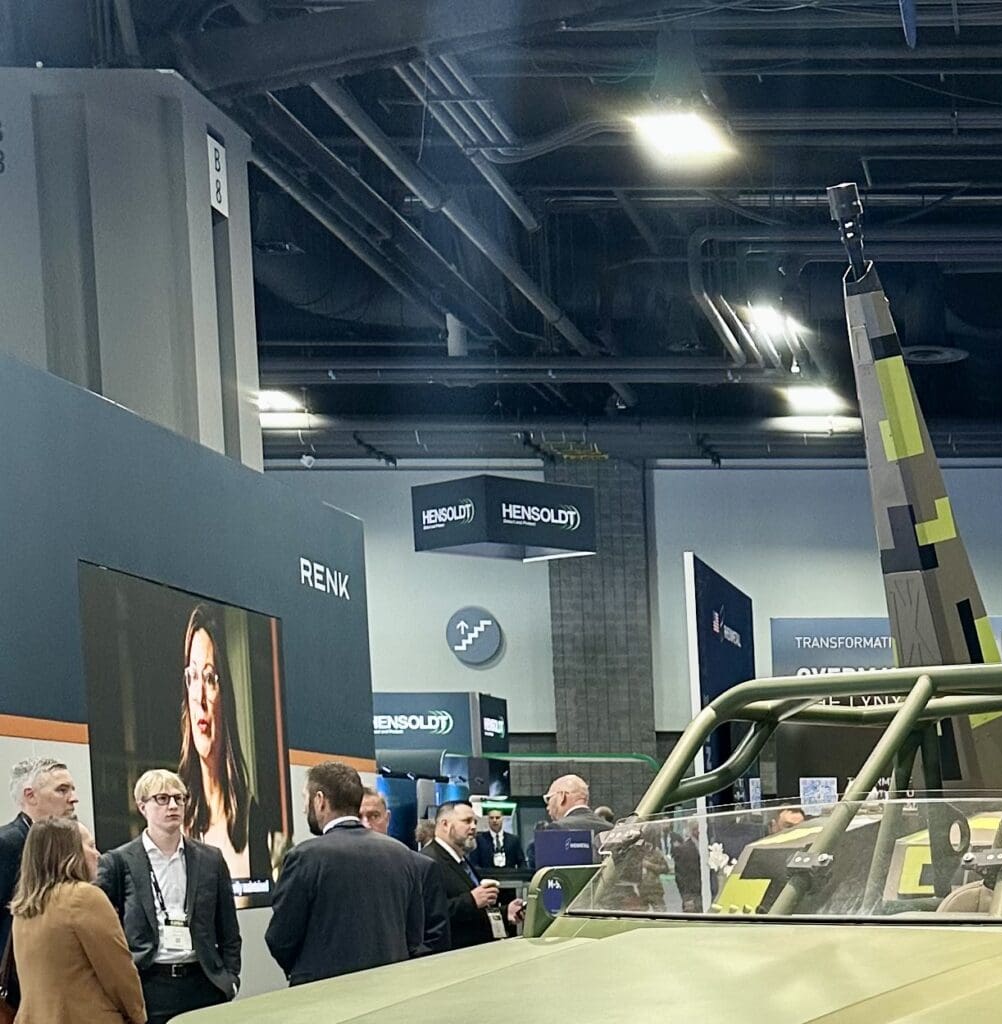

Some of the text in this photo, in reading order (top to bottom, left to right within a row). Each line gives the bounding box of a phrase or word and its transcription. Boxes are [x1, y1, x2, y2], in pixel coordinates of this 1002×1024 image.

[422, 502, 474, 525] HENSOLDT
[502, 503, 577, 526] HENSOLDT
[300, 557, 350, 601] RENK
[795, 636, 893, 649] TRANSFORMATI
